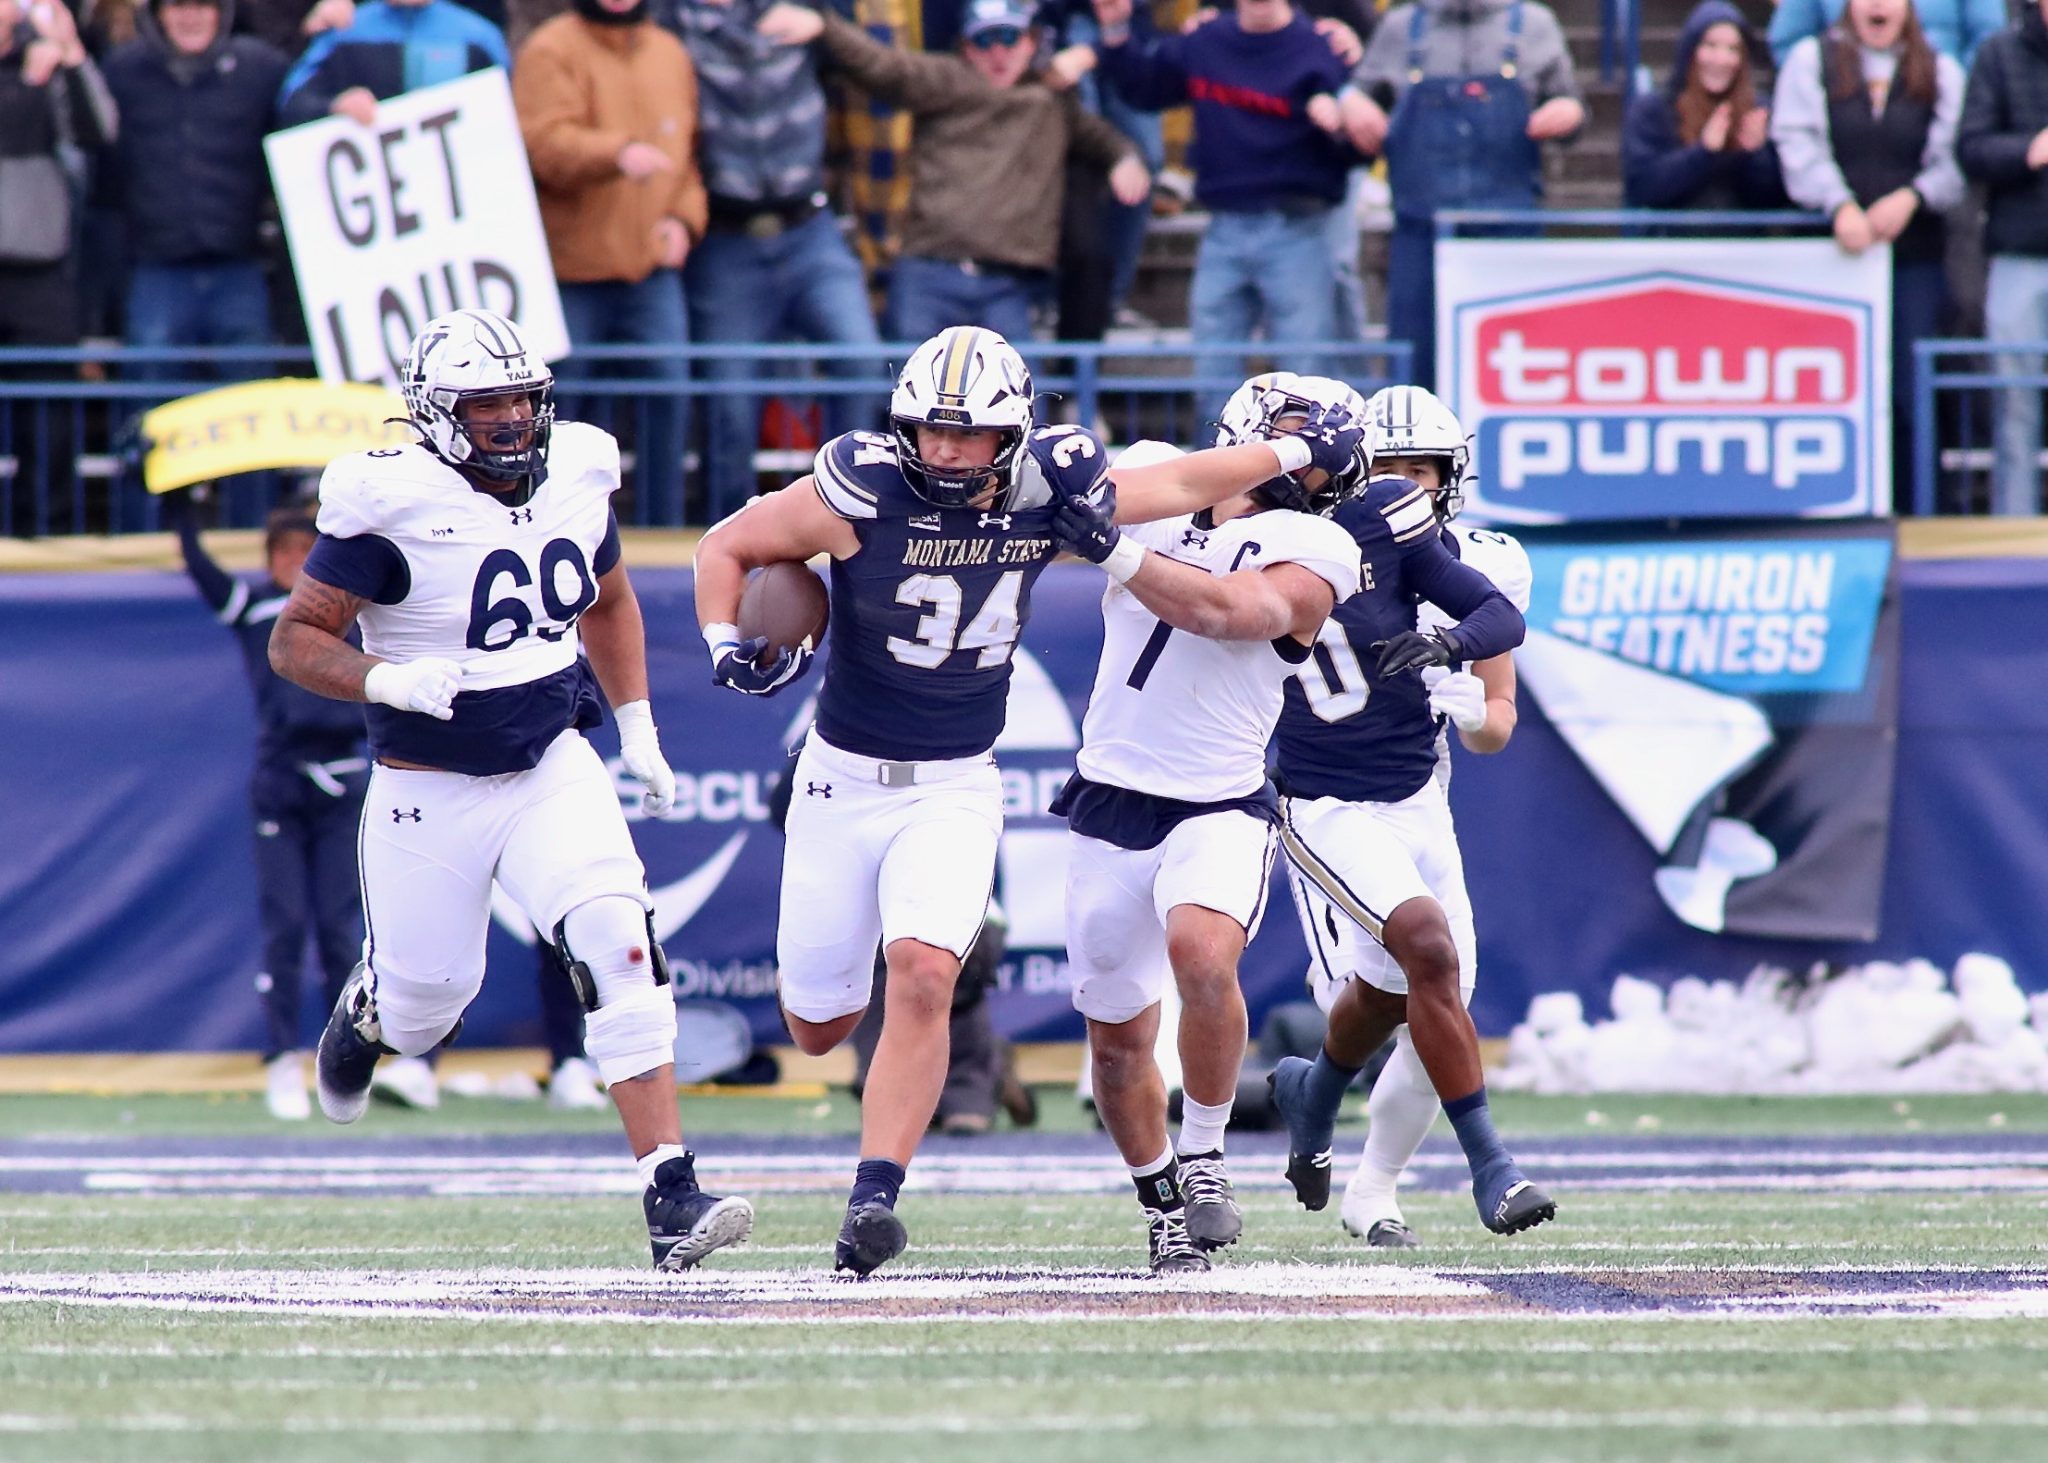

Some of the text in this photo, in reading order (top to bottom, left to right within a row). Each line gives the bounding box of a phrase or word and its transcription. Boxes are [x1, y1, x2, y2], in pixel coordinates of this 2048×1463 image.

[325, 109, 461, 247] GET
[506, 370, 533, 381] YALE
[1487, 330, 1845, 403] town
[286, 408, 413, 445] LOU
[938, 410, 961, 421] 406
[1385, 441, 1415, 450] YALE
[1500, 418, 1845, 490] pump
[902, 538, 994, 567] MONTANA
[1230, 541, 1261, 572] C
[466, 538, 596, 652] 69
[1559, 553, 1835, 616] GRIDIRON
[887, 570, 1024, 670] 34
[607, 757, 781, 822] Secu
